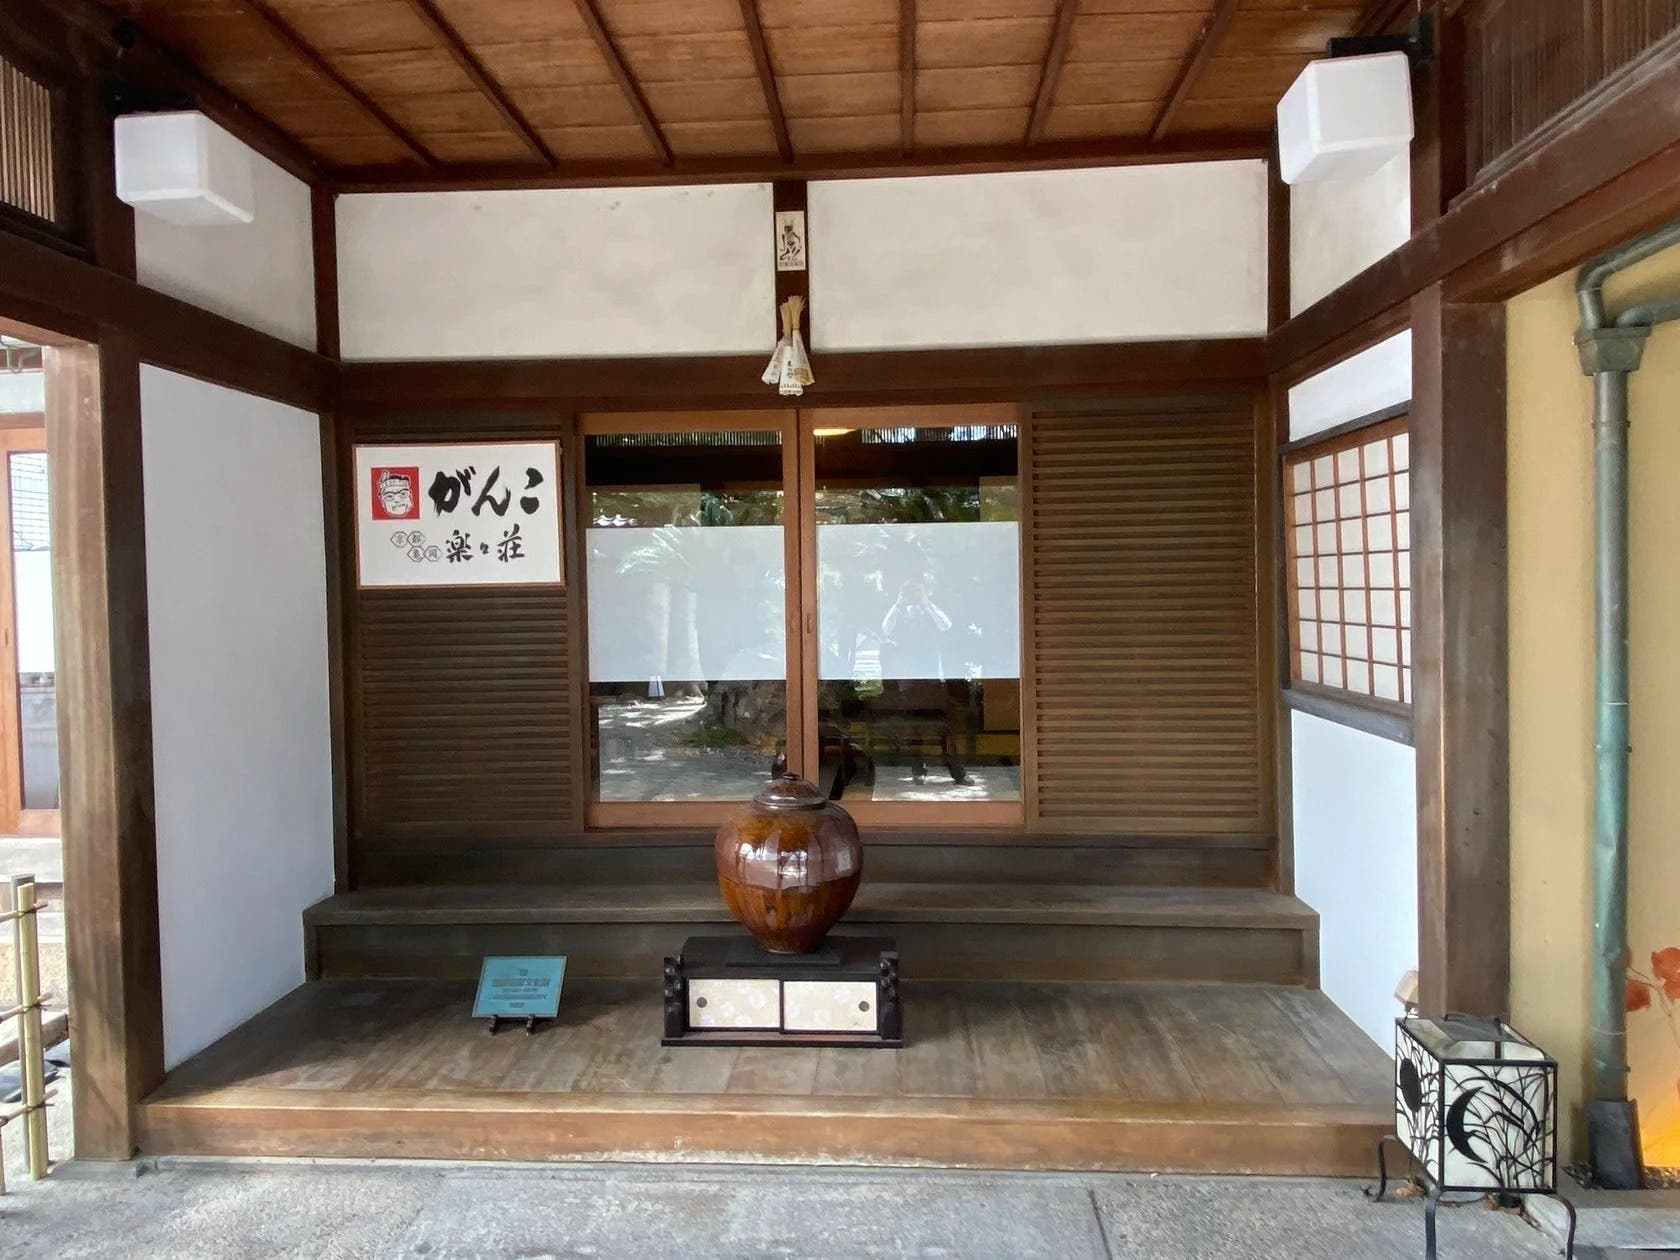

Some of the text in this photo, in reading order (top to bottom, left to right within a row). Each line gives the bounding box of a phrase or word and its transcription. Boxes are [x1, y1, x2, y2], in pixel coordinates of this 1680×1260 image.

[428, 465, 544, 518] がんこ
[445, 523, 526, 563] 楽々荘
